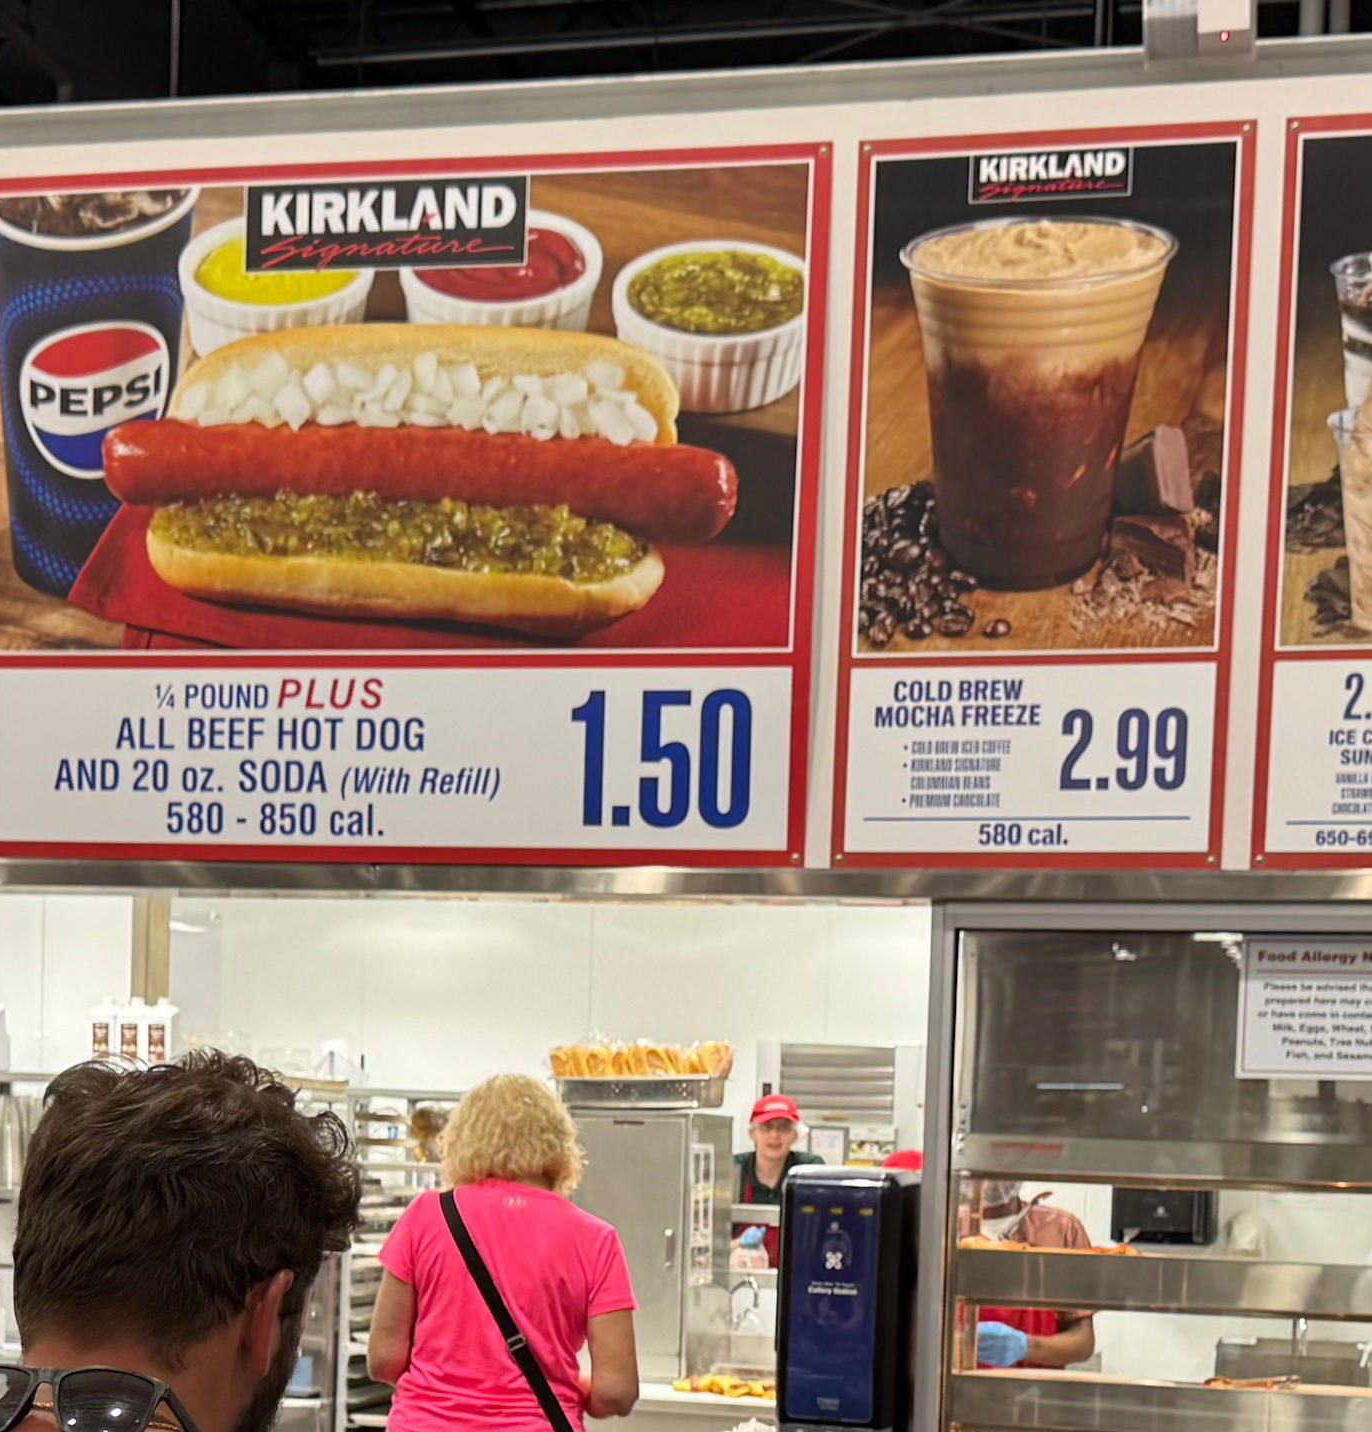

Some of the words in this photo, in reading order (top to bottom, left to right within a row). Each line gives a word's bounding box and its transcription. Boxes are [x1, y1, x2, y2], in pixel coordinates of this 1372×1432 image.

[979, 151, 1125, 182] KIRKLAND
[979, 178, 1123, 201] Signature
[261, 183, 516, 235] KIRKLAND
[261, 234, 514, 273] Signature
[30, 366, 162, 416] PEPSI
[184, 684, 269, 709] POUND
[277, 679, 384, 710] PLUS
[894, 681, 952, 702] COLD
[959, 680, 1024, 701] BREW
[875, 707, 955, 728] MOCHA
[962, 705, 1040, 726] FREEZE
[116, 718, 174, 750] ALL
[188, 718, 265, 750] BEEF
[278, 717, 343, 750] HOT
[356, 717, 425, 751] DOG
[1060, 708, 1188, 791] 2.99
[1329, 730, 1356, 745] ICE
[571, 688, 752, 829] 1.50
[54, 760, 121, 792] AND
[132, 760, 169, 792] 20
[182, 766, 223, 792] oz.
[239, 760, 327, 793] SODA
[341, 766, 410, 800] (With
[419, 766, 501, 801] Refill)
[167, 802, 223, 834] 580
[260, 803, 316, 835] 850
[330, 803, 384, 836] cal.
[979, 824, 1021, 846] 580
[1028, 823, 1068, 846] cal.
[1257, 951, 1296, 962] Food
[1301, 951, 1358, 965] Allergy
